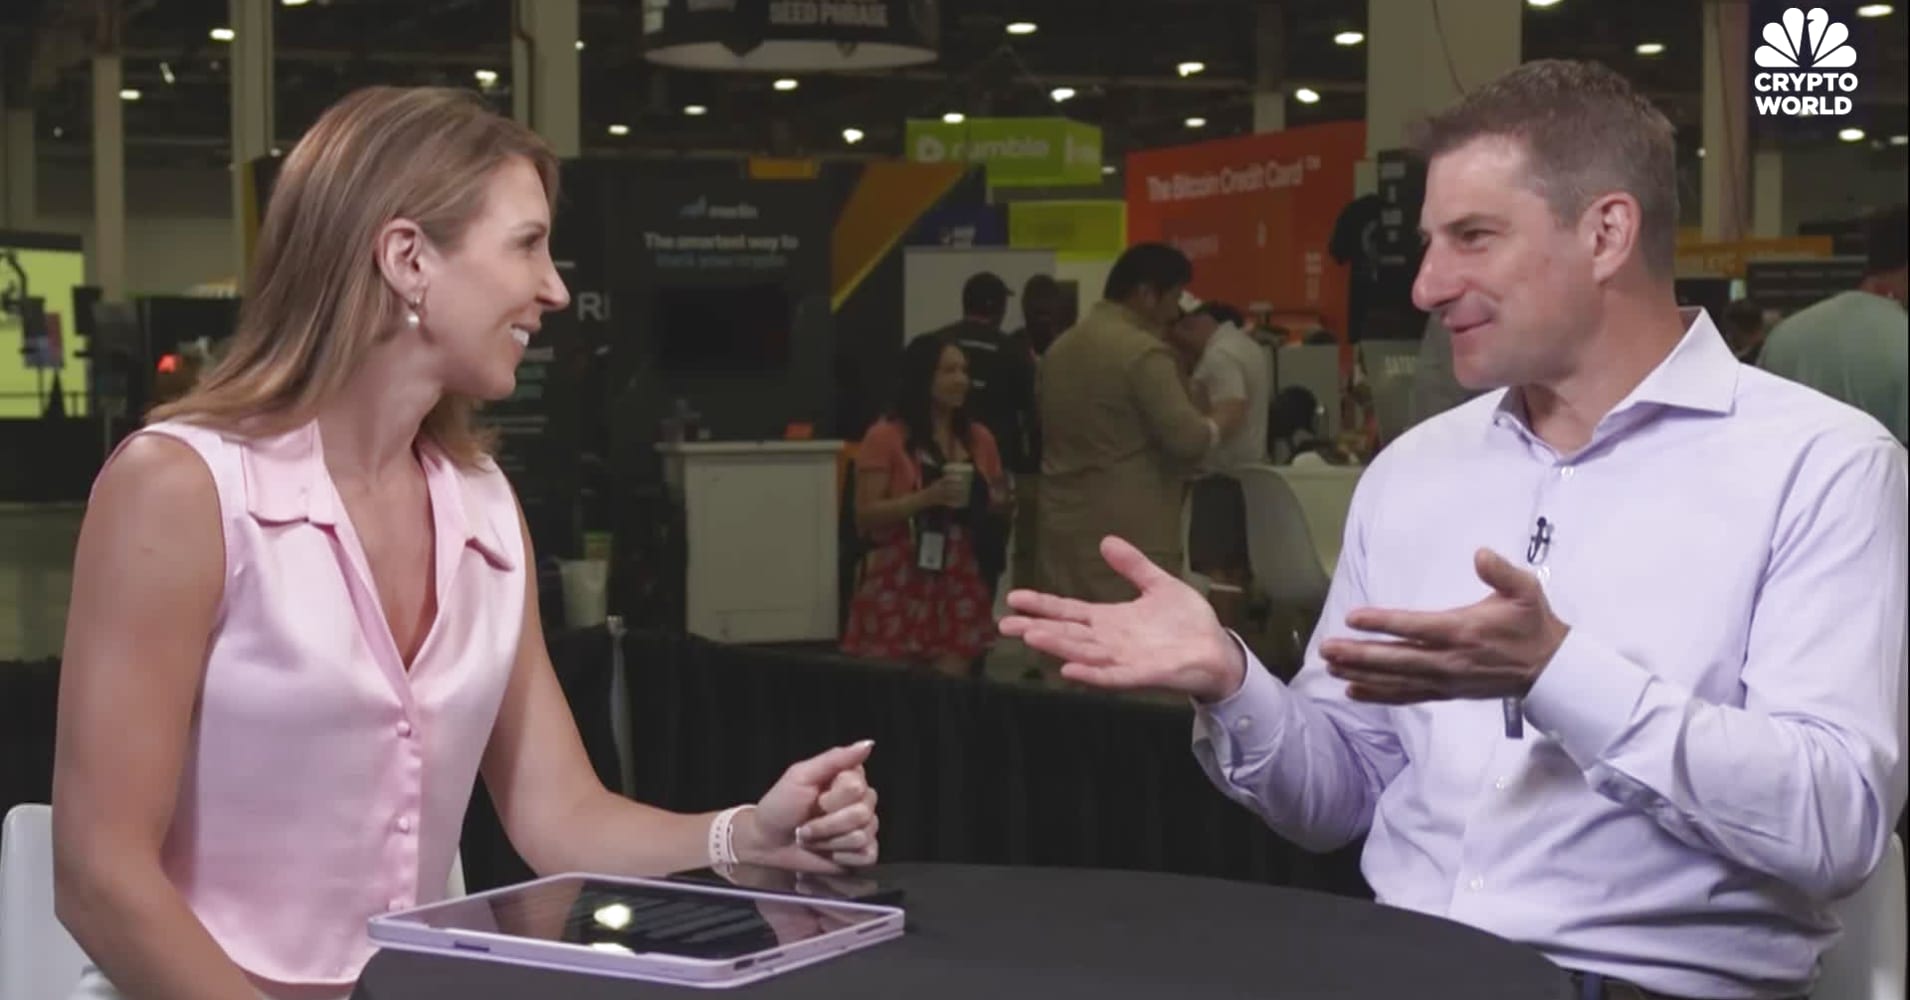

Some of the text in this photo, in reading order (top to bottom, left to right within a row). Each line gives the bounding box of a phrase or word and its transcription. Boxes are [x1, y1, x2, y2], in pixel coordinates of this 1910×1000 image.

[1146, 174, 1171, 202] The
[1172, 171, 1219, 200] Bitcoin
[1220, 163, 1265, 195] Credit
[1265, 157, 1303, 188] Card
[643, 232, 674, 249] The
[748, 236, 779, 254] way
[781, 234, 799, 249] to
